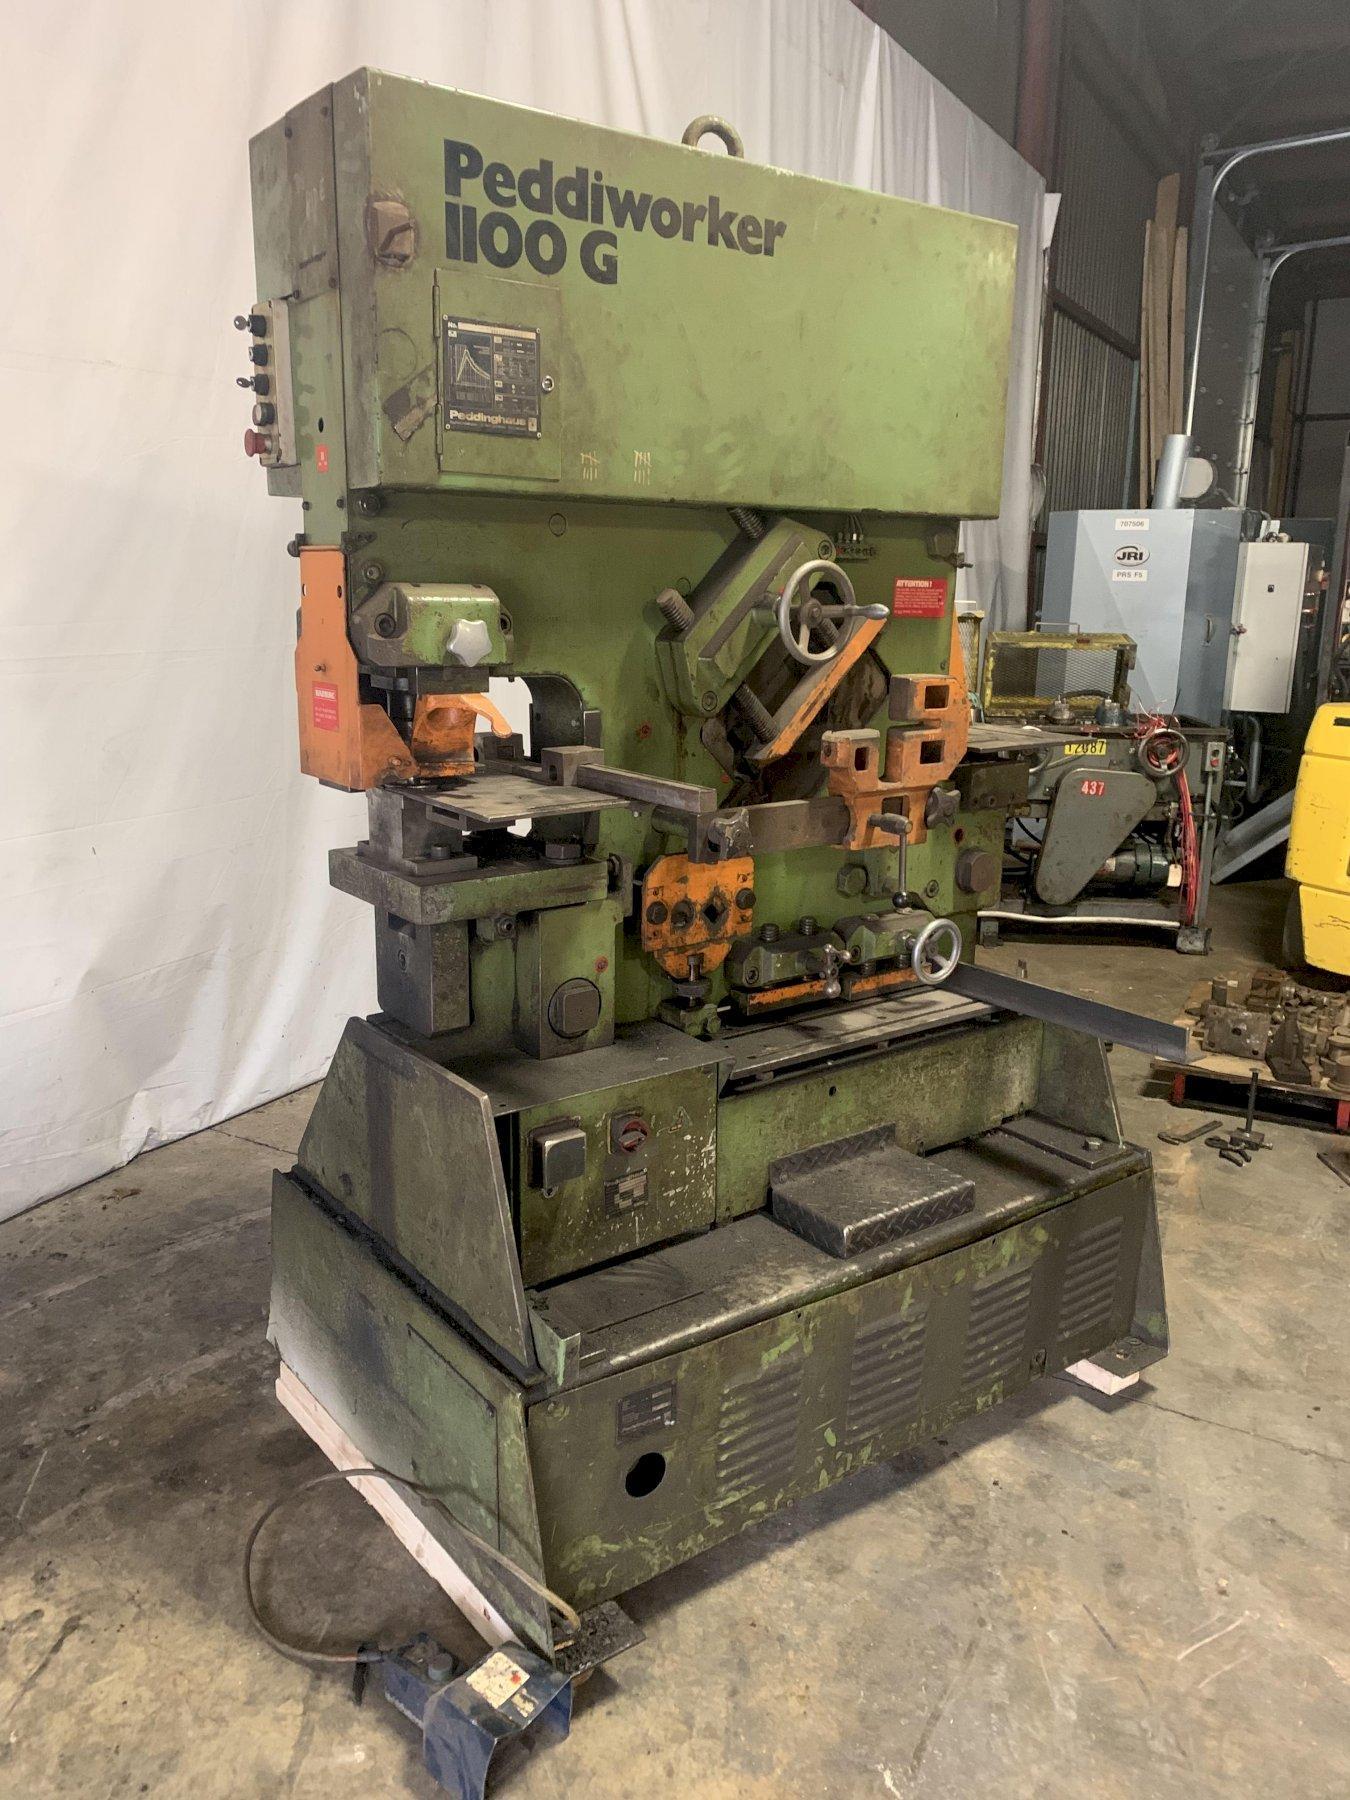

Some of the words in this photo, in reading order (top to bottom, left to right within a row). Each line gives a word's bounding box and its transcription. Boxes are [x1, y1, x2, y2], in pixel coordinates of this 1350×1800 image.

[444, 138, 787, 257] Peddiworker
[444, 201, 567, 276] 1100
[579, 230, 618, 285] G
[449, 409, 527, 426] Peddinghaus
[1117, 552, 1143, 560] JRI
[1081, 780, 1105, 796] 437
